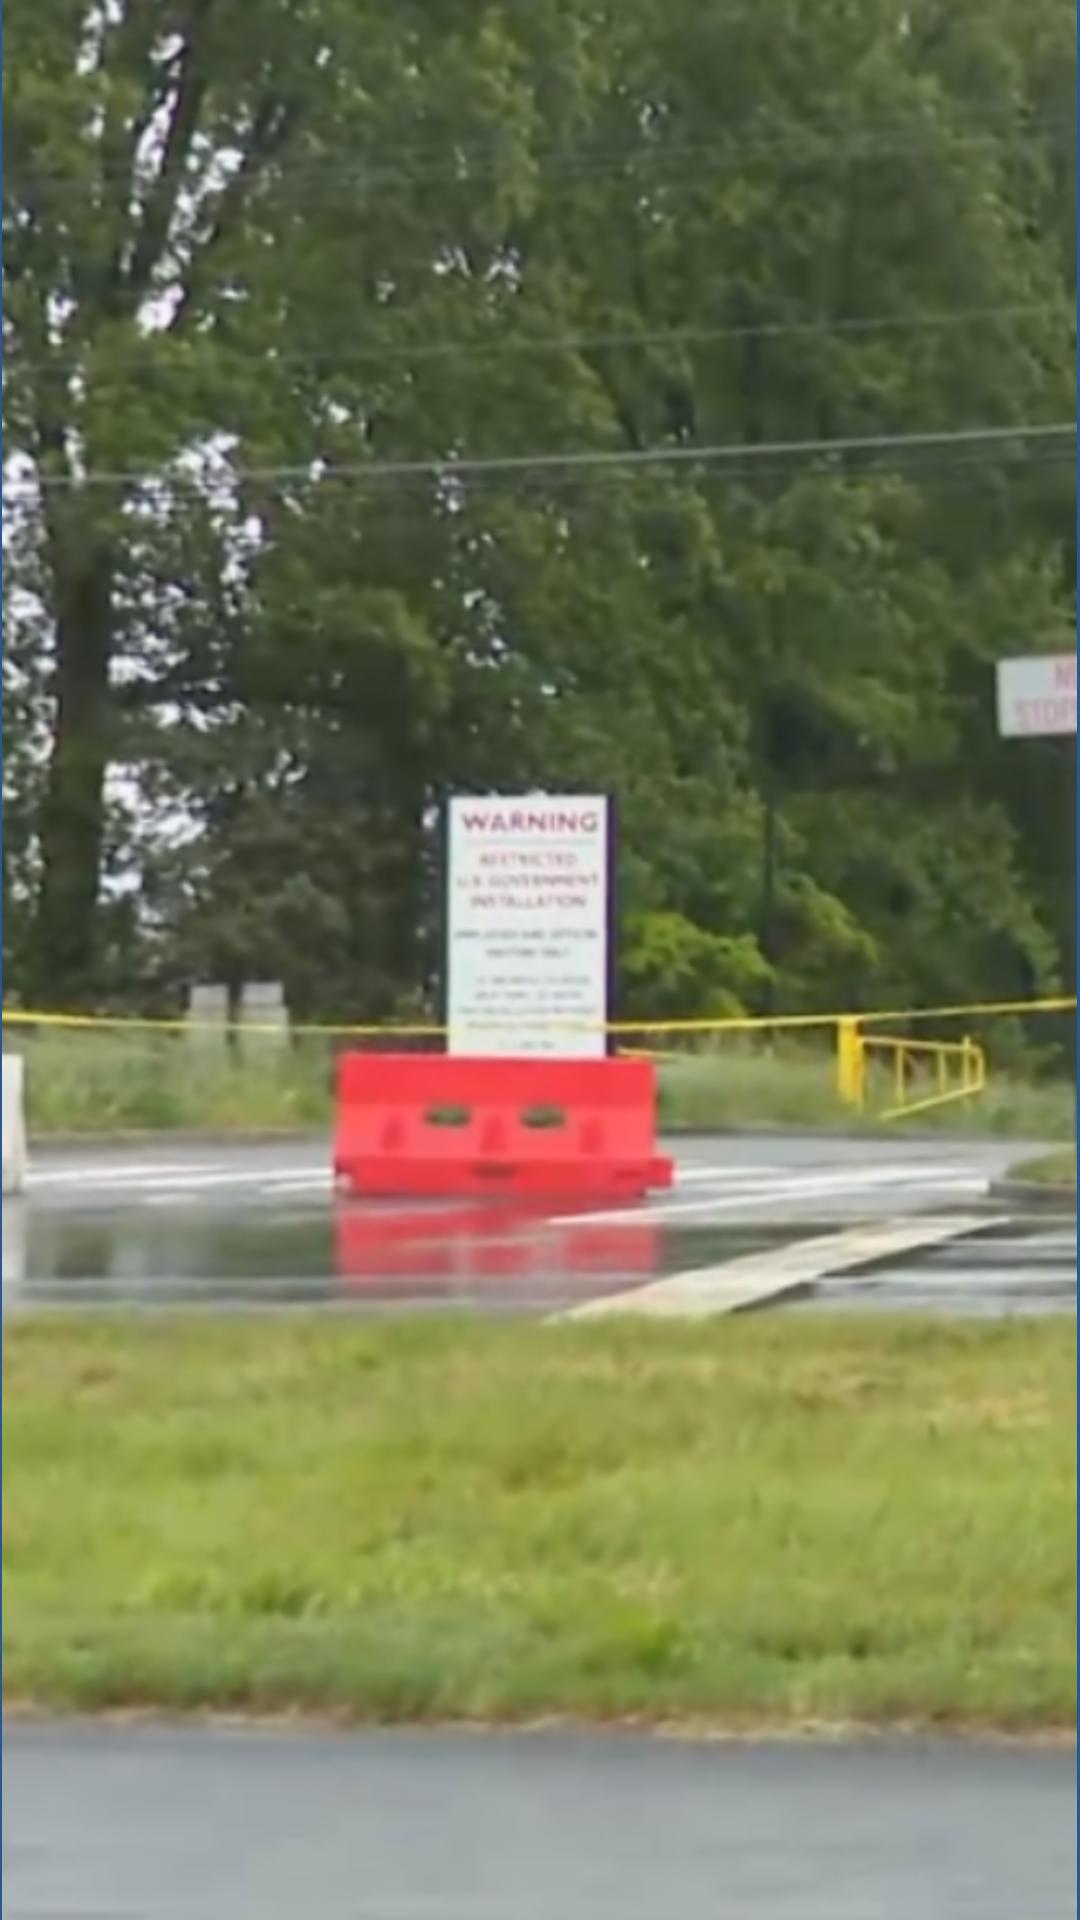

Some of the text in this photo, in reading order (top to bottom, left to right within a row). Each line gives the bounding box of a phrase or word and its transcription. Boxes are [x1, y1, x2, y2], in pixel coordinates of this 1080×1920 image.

[1015, 698, 1076, 729] STOP
[461, 810, 598, 833] WARNING
[479, 852, 578, 868] RESTRICTED
[488, 871, 598, 889] GOVERNMENT
[470, 894, 587, 910] INSTALLATION
